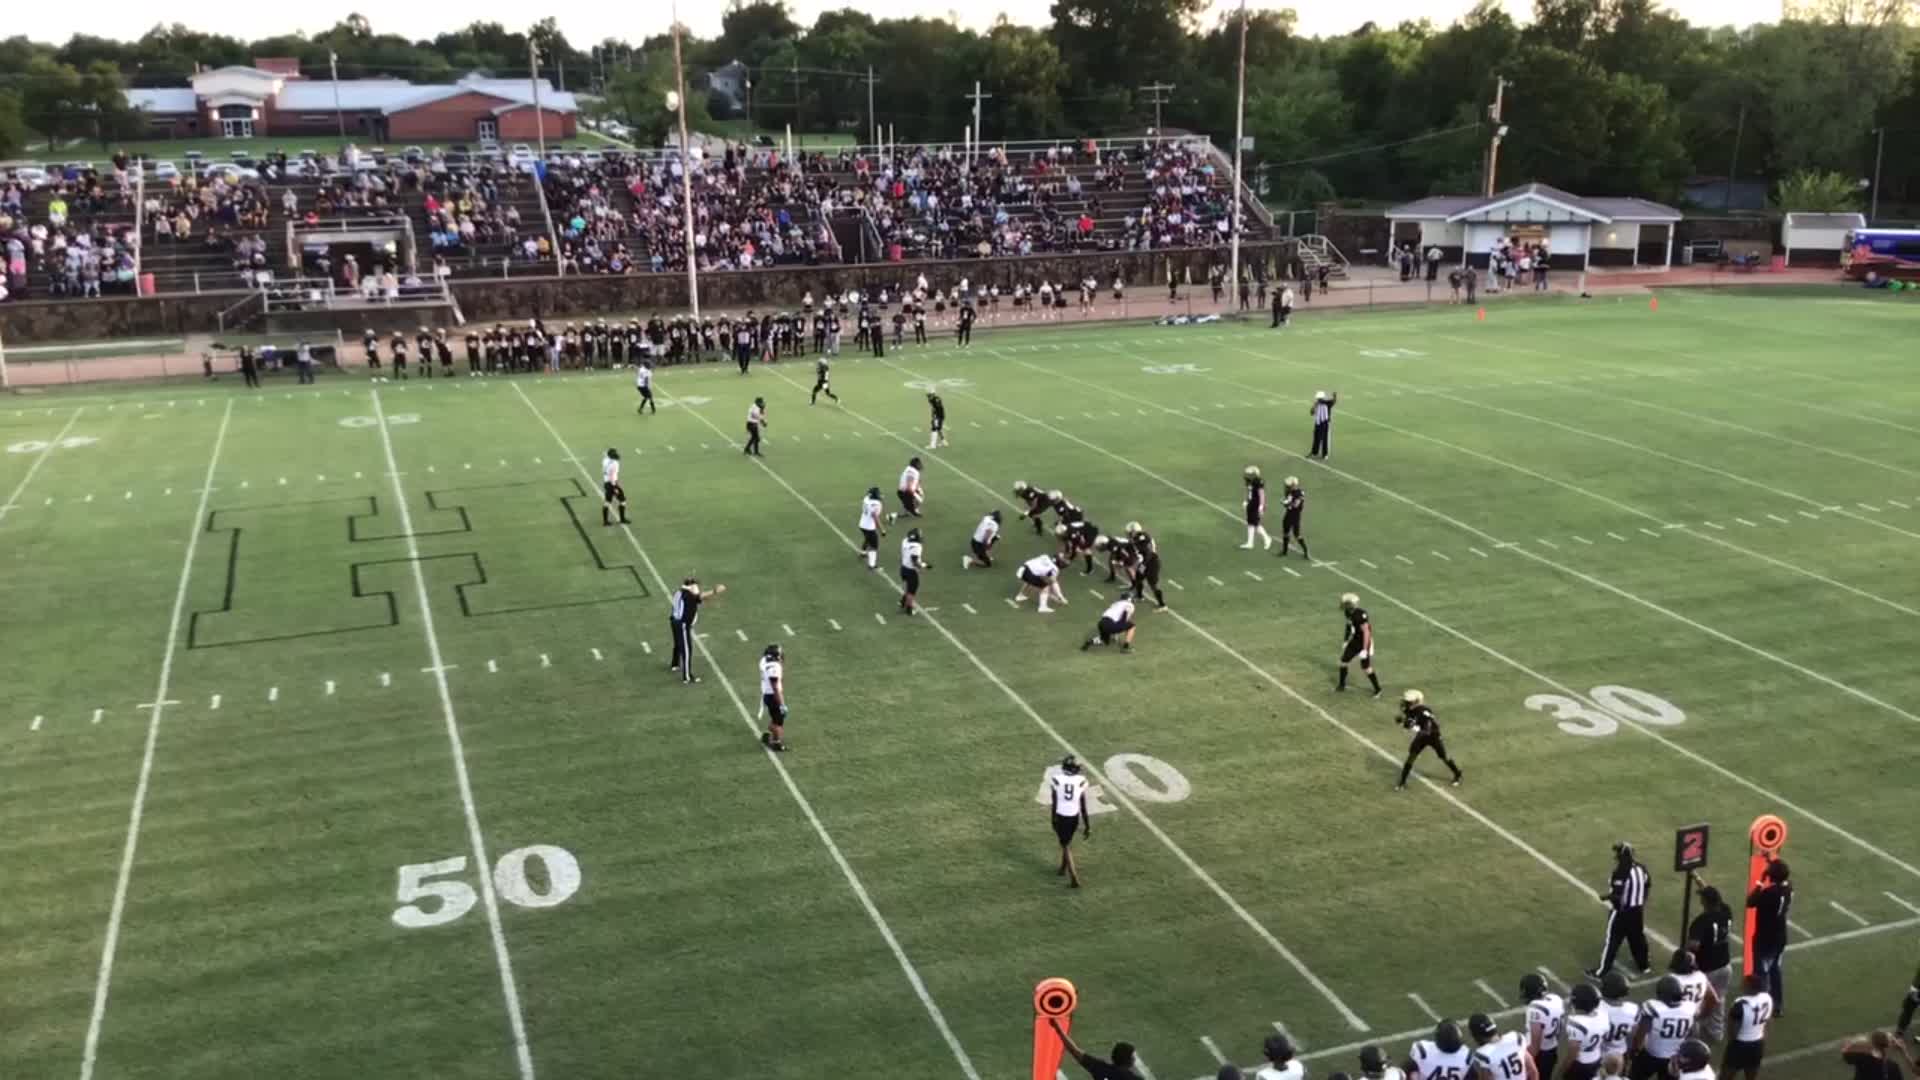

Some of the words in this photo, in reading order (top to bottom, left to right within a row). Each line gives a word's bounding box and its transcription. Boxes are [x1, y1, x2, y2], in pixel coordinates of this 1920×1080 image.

[1524, 685, 1686, 736] 30
[1064, 783, 1074, 801] 9
[1683, 831, 1704, 860] 2
[392, 844, 582, 929] 50
[1752, 1001, 1770, 1026] 12
[1660, 1018, 1688, 1039] 50
[1501, 1052, 1522, 1080] 15
